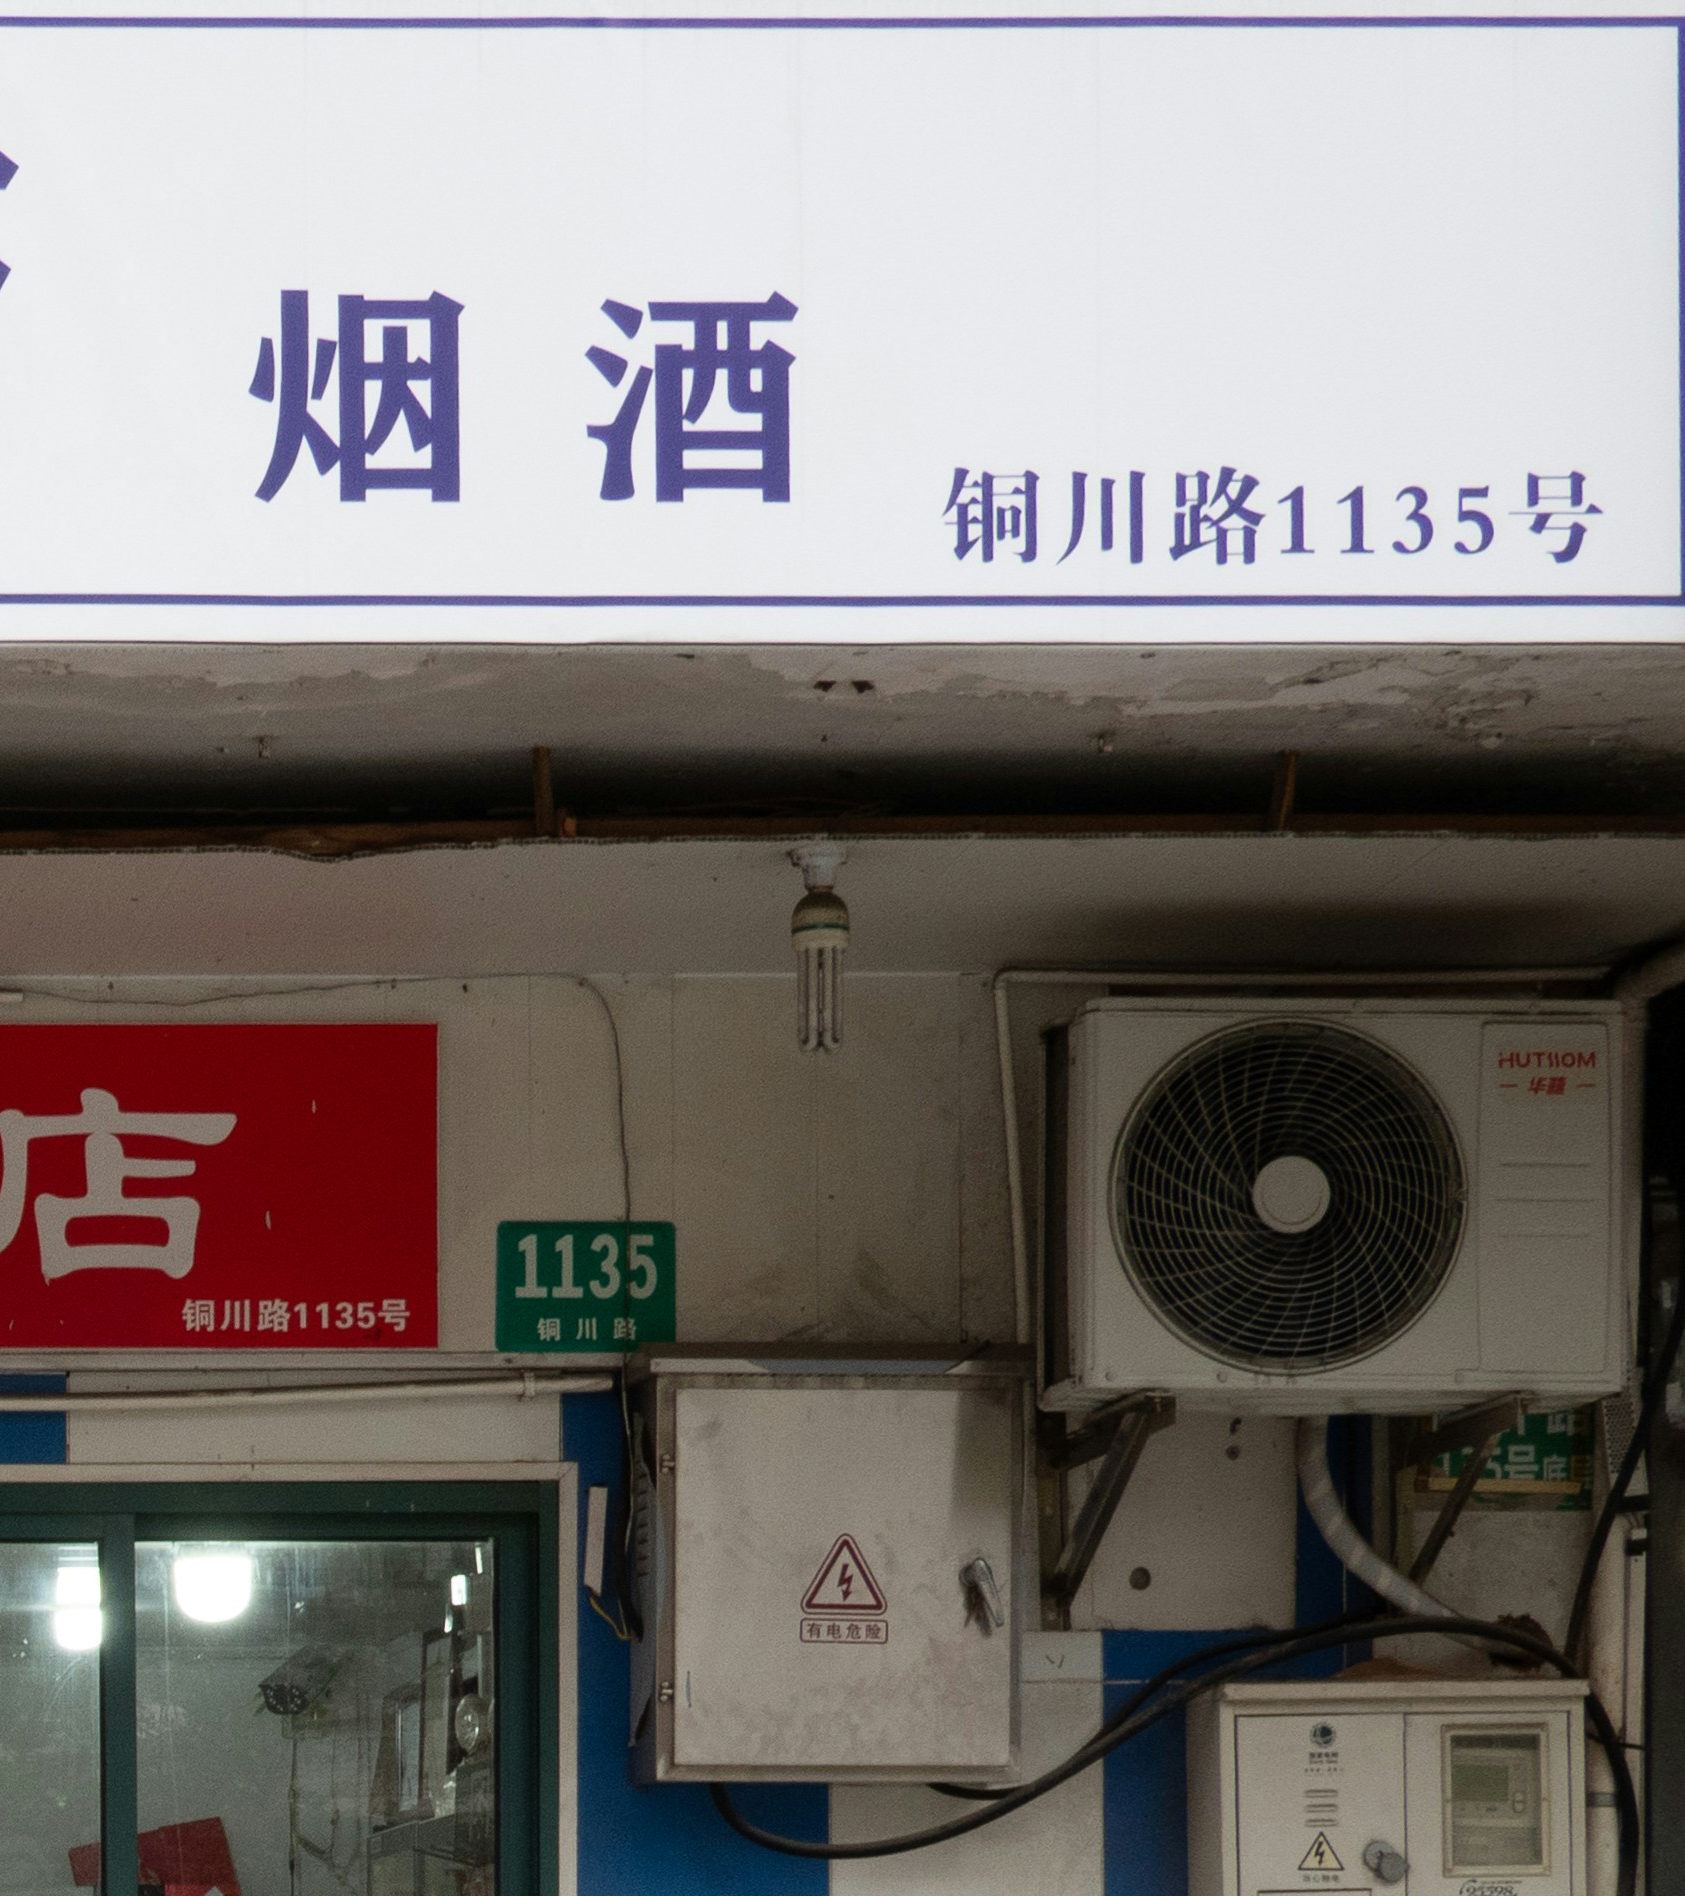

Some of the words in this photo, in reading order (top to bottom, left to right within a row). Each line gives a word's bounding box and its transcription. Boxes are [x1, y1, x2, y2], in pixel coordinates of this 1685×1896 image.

[249, 287, 803, 507] 烟酒
[941, 465, 1604, 565] 铜川路1135号
[514, 1232, 659, 1300] 1135
[181, 1297, 411, 1334] 铜川路1135号
[536, 1316, 638, 1342] 铜川路
[806, 1622, 882, 1642] 有电危险
